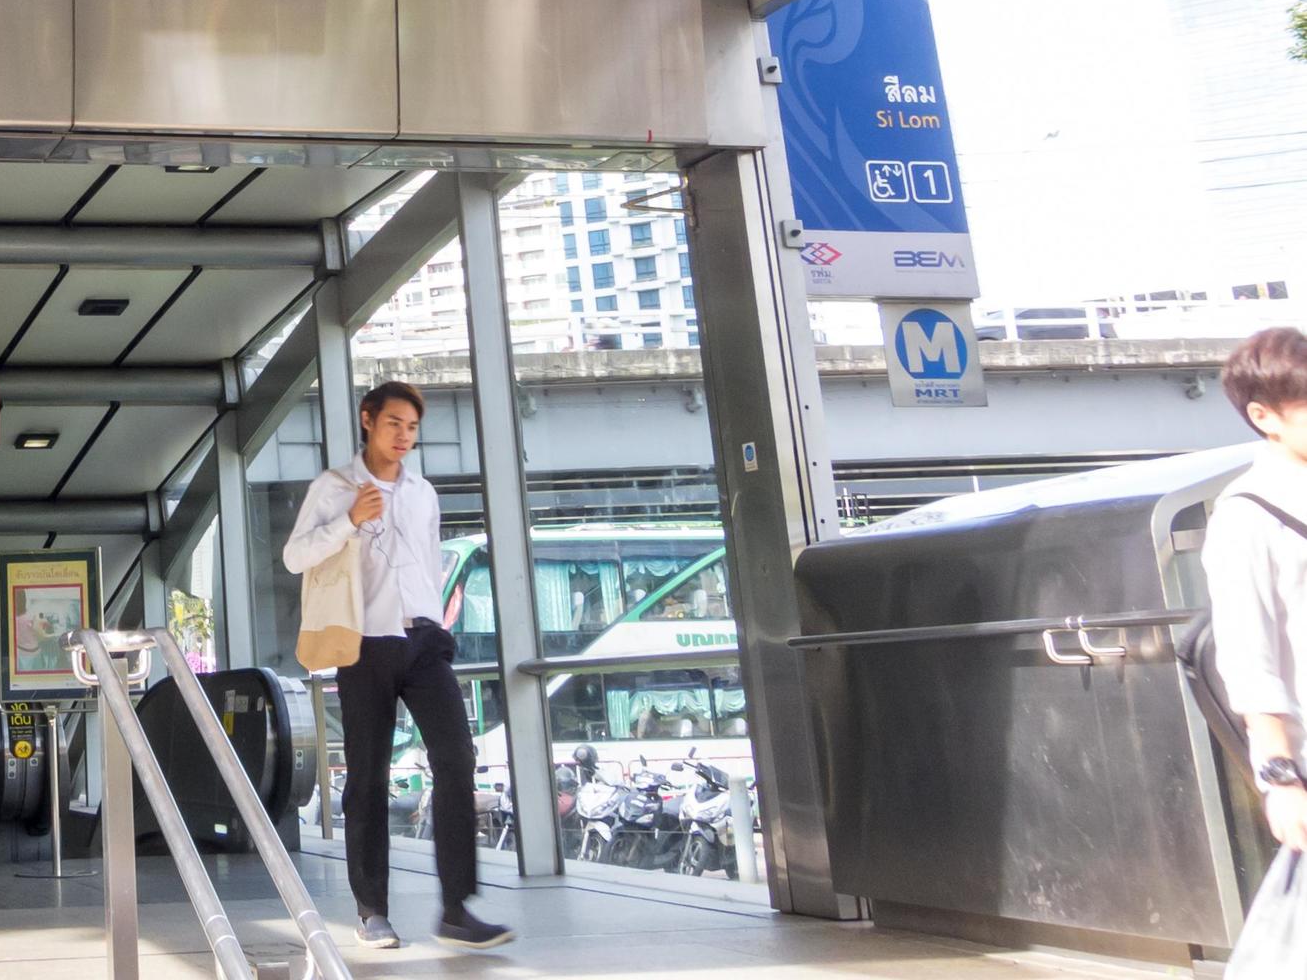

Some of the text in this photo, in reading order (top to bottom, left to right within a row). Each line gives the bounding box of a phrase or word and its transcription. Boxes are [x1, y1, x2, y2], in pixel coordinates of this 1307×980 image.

[883, 75, 937, 104] สีลม
[876, 110, 941, 129] Si Lom
[923, 169, 937, 196] 1
[893, 250, 965, 268] BEM
[901, 321, 962, 374] M
[915, 388, 961, 398] MRT
